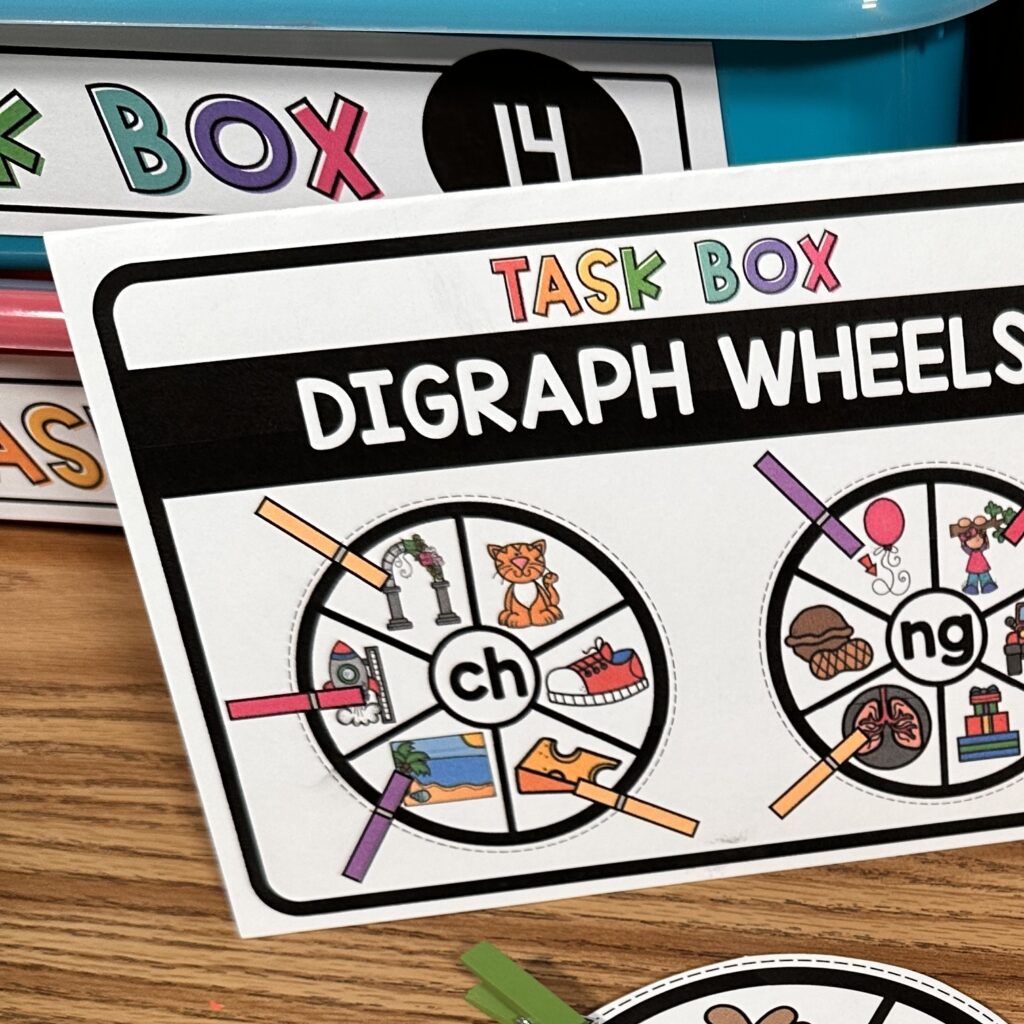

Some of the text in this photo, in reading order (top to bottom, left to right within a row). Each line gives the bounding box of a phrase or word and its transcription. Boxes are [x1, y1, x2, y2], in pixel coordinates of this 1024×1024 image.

[85, 82, 384, 202] BOX
[493, 103, 573, 187] 14
[490, 229, 842, 323] TASK BOX
[296, 340, 695, 451] DIGRAPH
[449, 646, 529, 702] ch
[900, 613, 975, 667] ng
